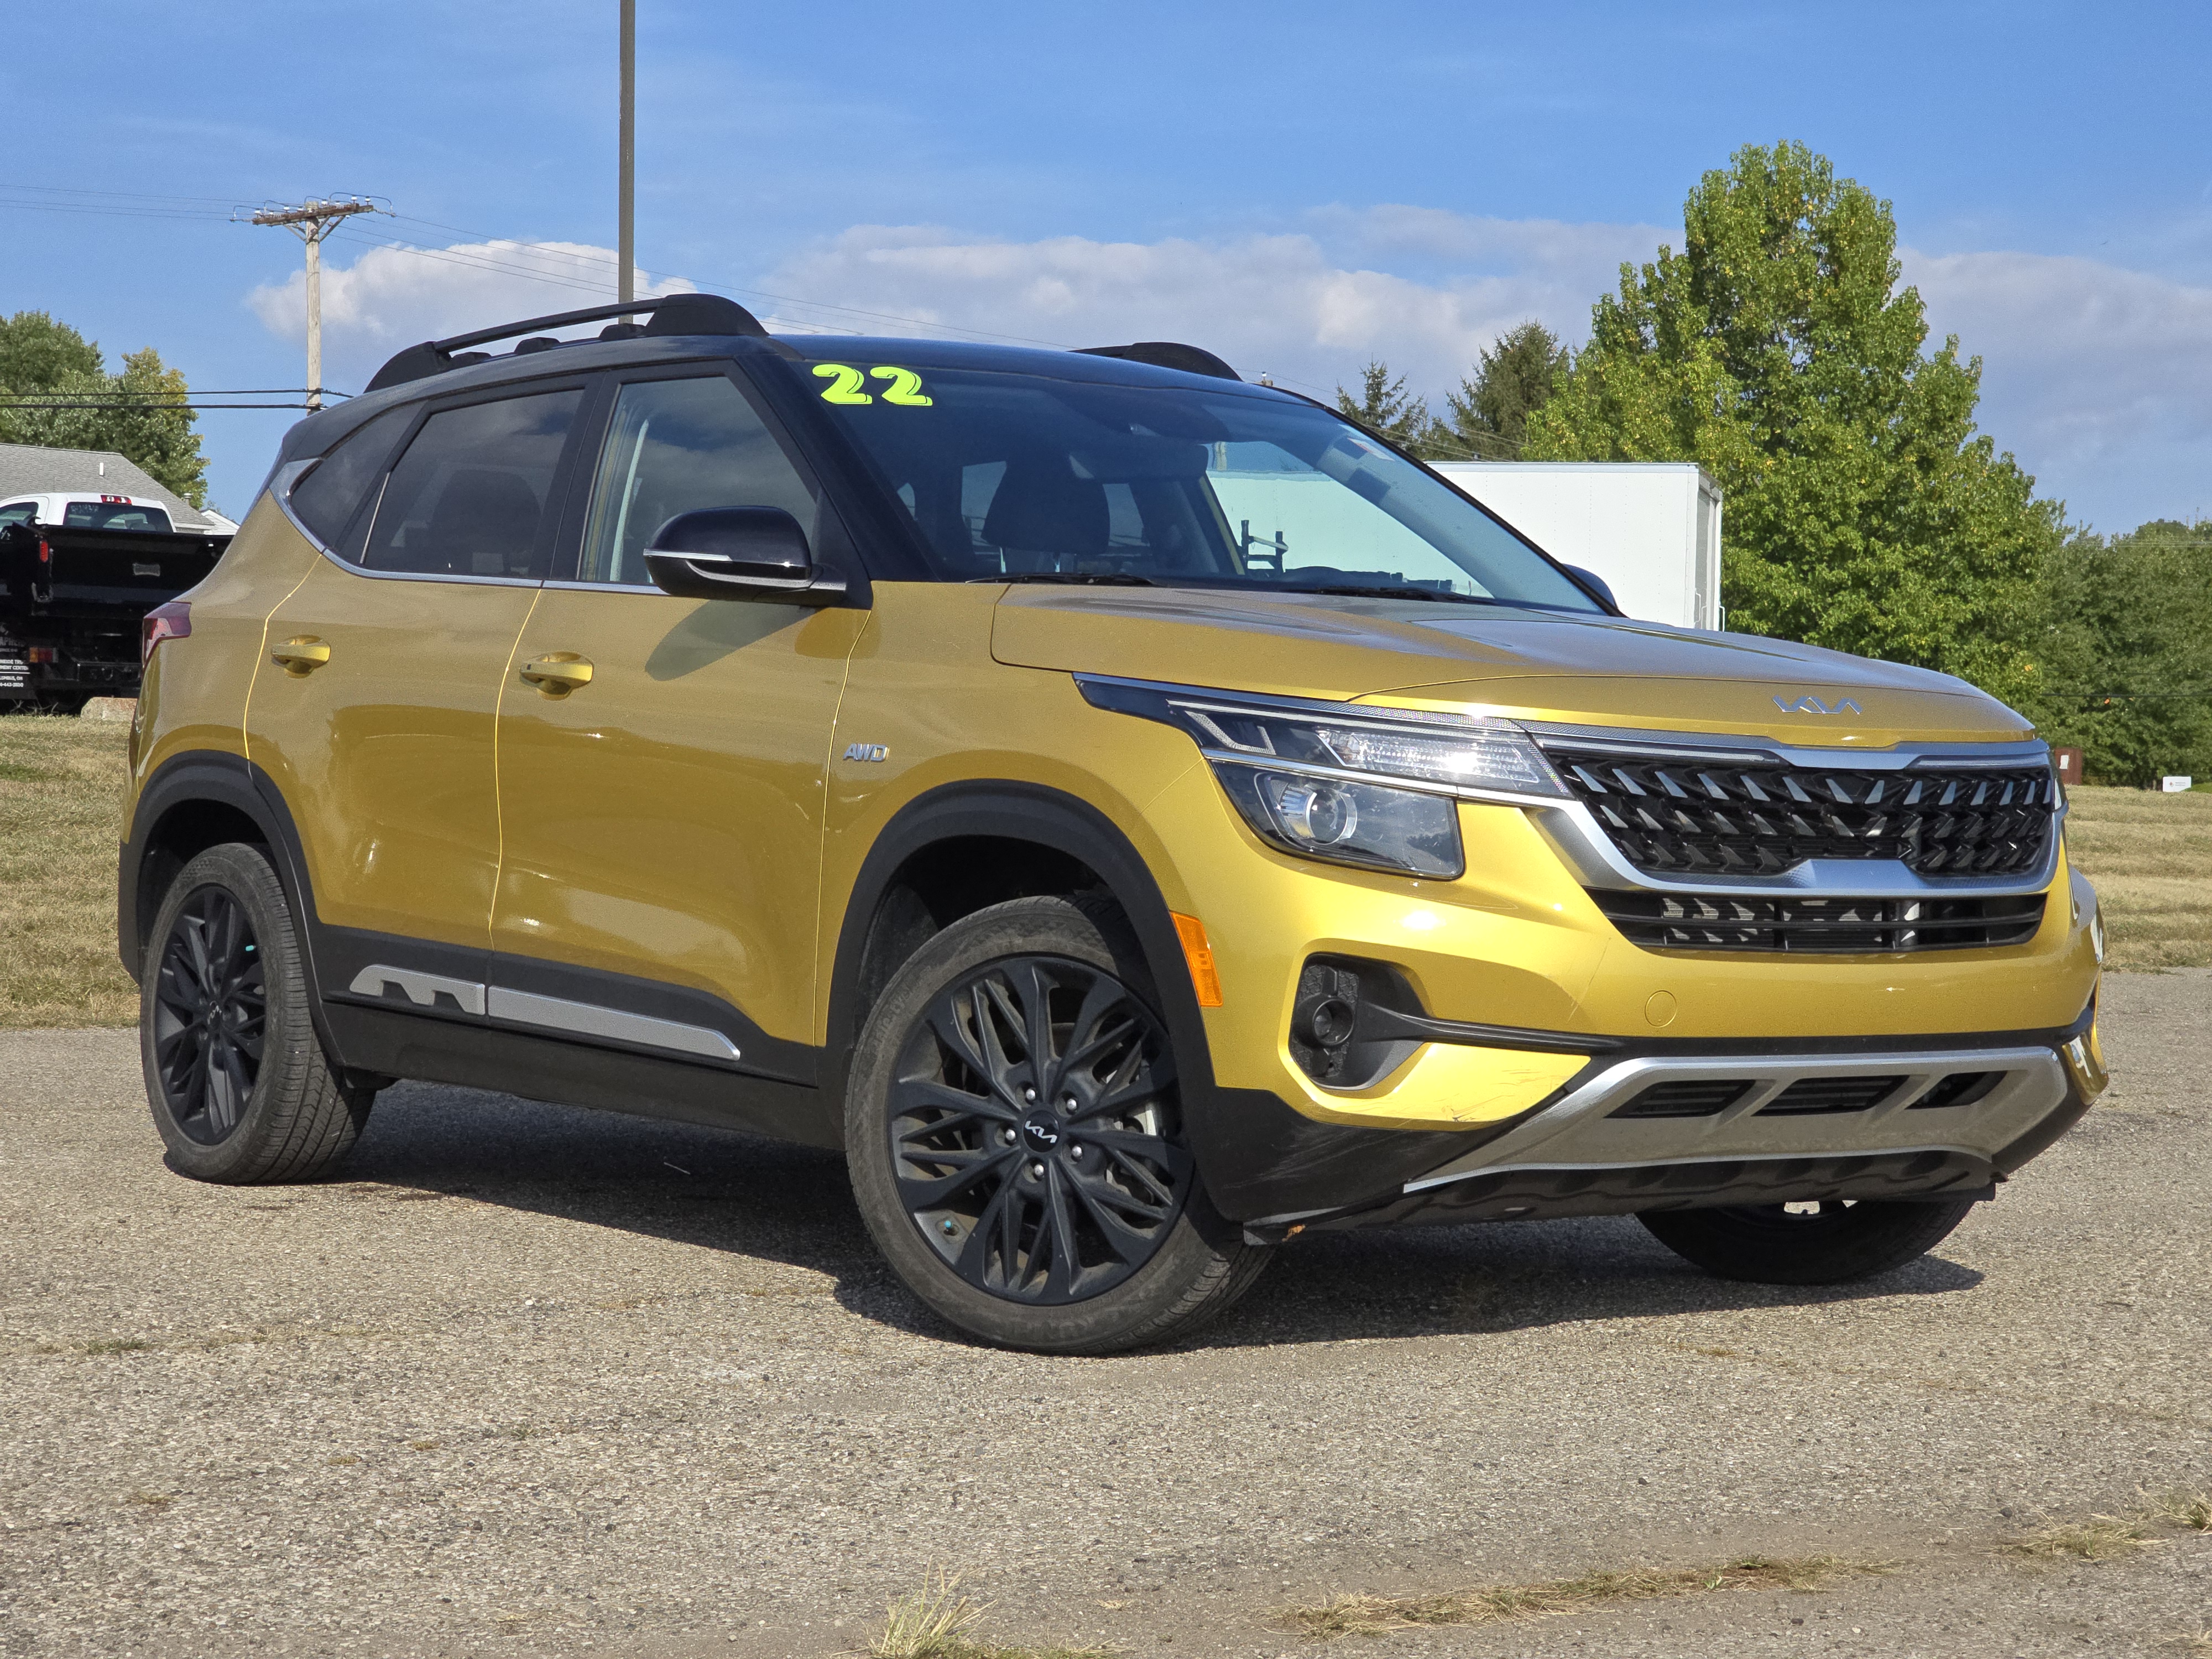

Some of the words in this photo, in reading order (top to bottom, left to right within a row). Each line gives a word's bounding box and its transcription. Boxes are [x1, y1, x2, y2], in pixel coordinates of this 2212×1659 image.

[812, 364, 933, 406] 22
[1772, 695, 1864, 714] KIA
[842, 743, 889, 761] AWD
[1025, 1120, 1057, 1143] KIA
